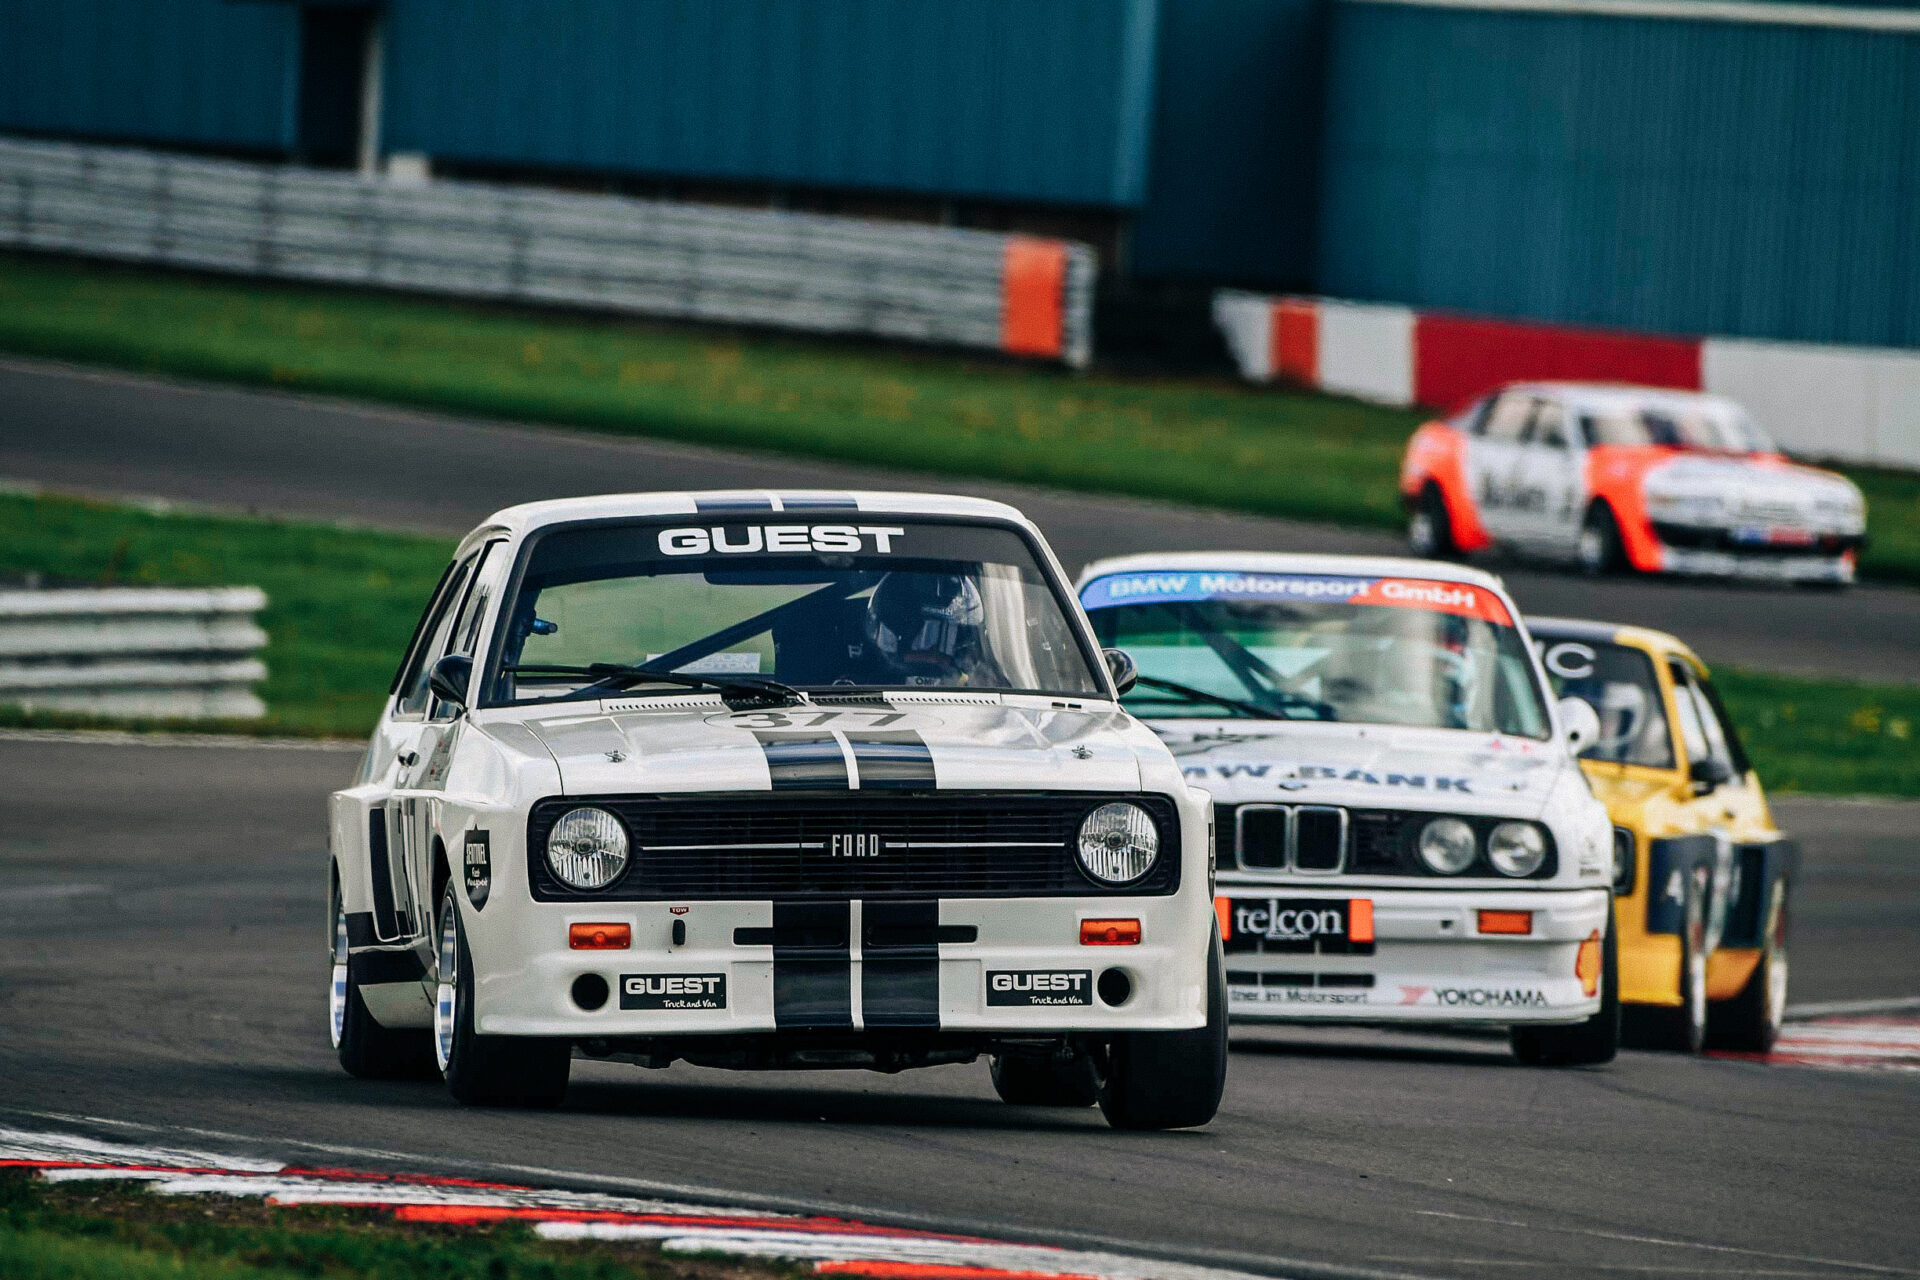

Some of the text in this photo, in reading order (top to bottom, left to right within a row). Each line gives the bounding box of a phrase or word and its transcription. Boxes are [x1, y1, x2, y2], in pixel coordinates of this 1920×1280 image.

[657, 525, 905, 556] GUEST
[1110, 574, 1476, 608] BMW Motorsport GmbH
[730, 711, 907, 728] 377
[1183, 764, 1272, 778] MW
[832, 833, 879, 857] FORD
[1236, 899, 1343, 935] telcon
[625, 977, 720, 994] GUEST
[992, 973, 1087, 991] GUEST
[663, 999, 717, 1008] Truck and Van
[1029, 995, 1083, 1004] Truck and Van
[1433, 988, 1548, 1006] YOKOHAMA
